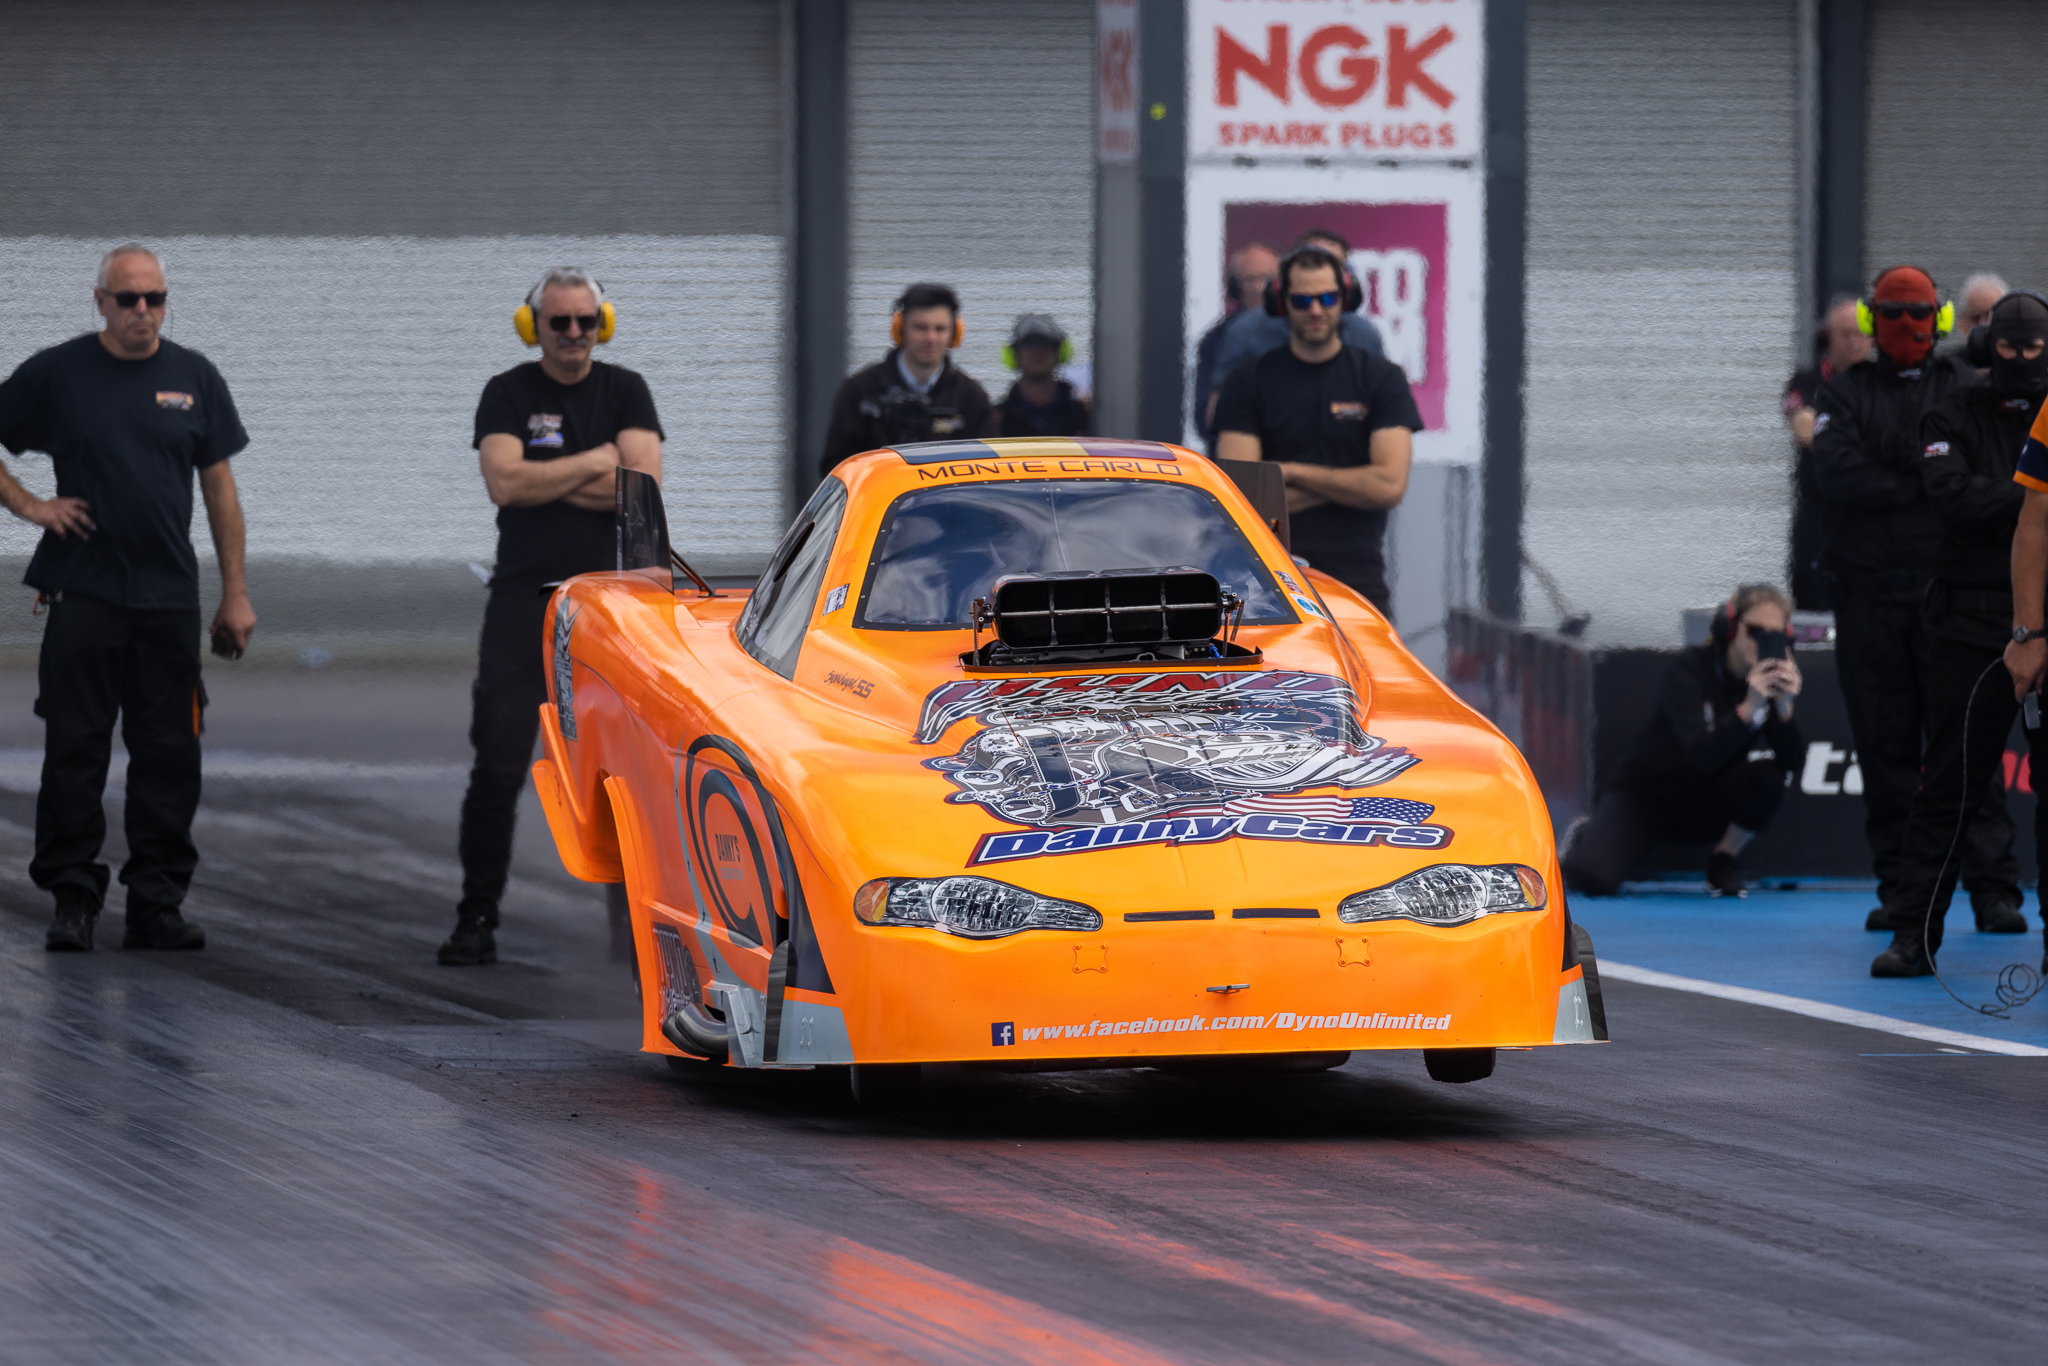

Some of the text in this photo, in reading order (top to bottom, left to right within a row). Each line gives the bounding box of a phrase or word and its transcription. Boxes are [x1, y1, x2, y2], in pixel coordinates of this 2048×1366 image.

[1213, 22, 1457, 110] NGK
[1218, 121, 1456, 148] SPARK PLUGS
[917, 460, 1183, 481] MONTE CARLO
[852, 679, 876, 699] SS
[977, 812, 1444, 863] DannyCars
[1021, 1012, 1451, 1041] www.facebook.com/DynoUnlimited
